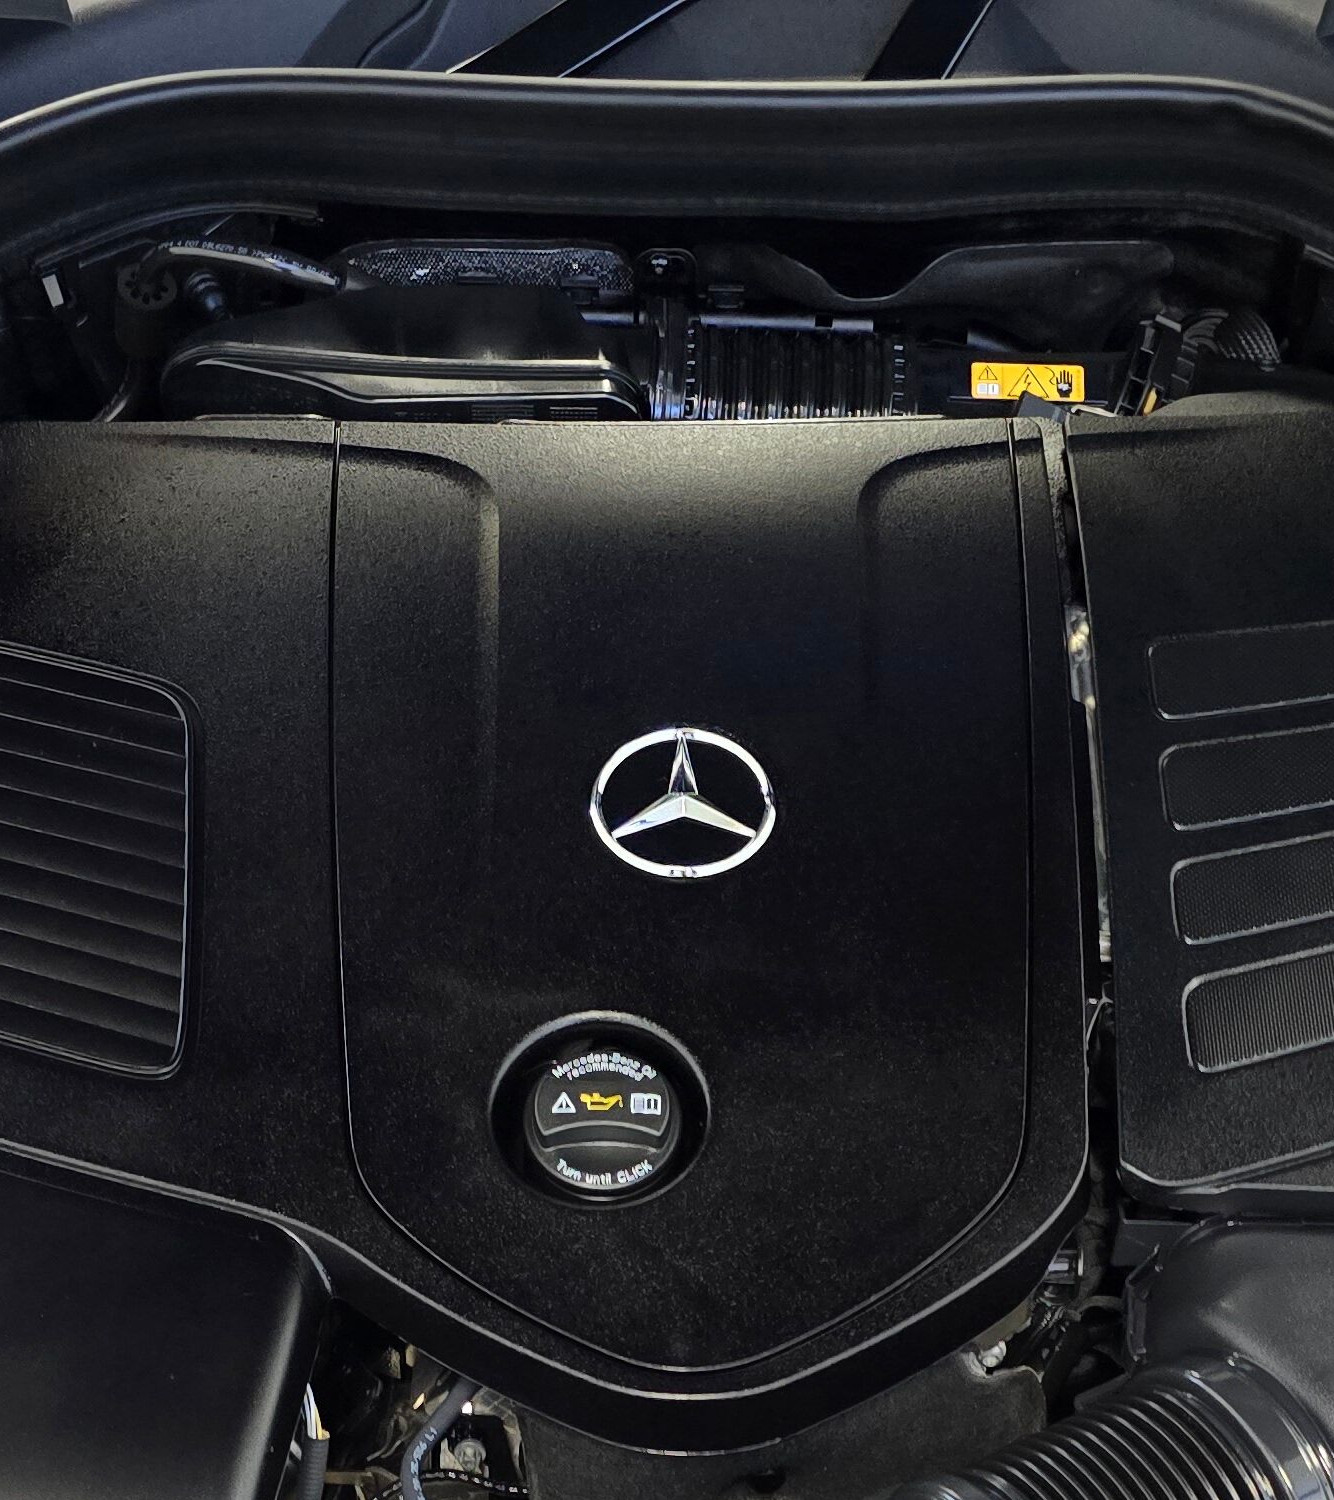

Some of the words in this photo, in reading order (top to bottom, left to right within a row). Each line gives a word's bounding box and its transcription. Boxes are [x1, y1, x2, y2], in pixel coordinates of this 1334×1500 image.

[552, 1052, 641, 1079] Mercedes-Benz
[566, 1062, 645, 1082] recommended
[556, 1157, 583, 1181] Turn
[585, 1172, 613, 1186] until
[617, 1159, 653, 1184] CLICK
